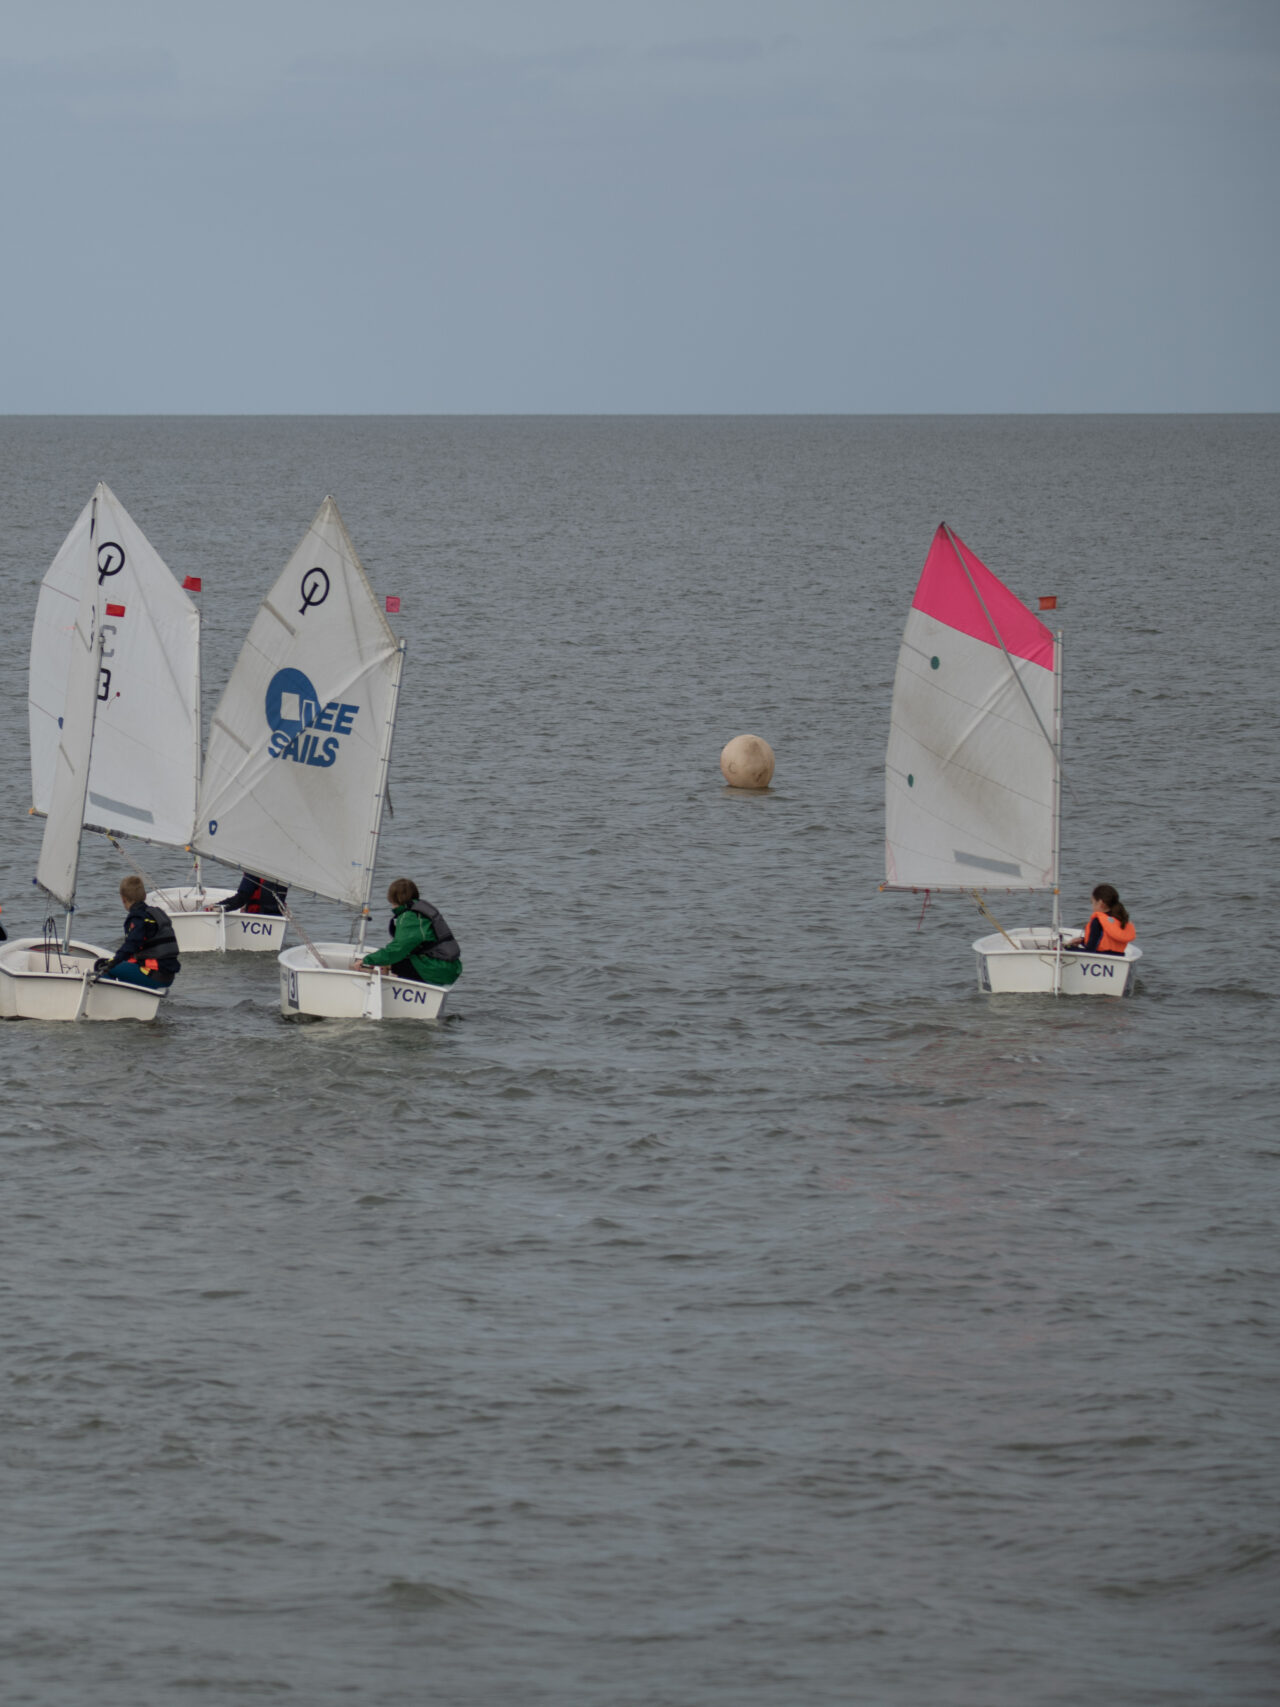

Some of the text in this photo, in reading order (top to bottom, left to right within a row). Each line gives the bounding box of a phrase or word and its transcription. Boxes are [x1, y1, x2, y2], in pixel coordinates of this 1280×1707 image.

[268, 734, 339, 768] SAILS
[241, 921, 273, 936] YCN
[1080, 963, 1114, 977] YCN
[391, 986, 427, 1005] YCN
